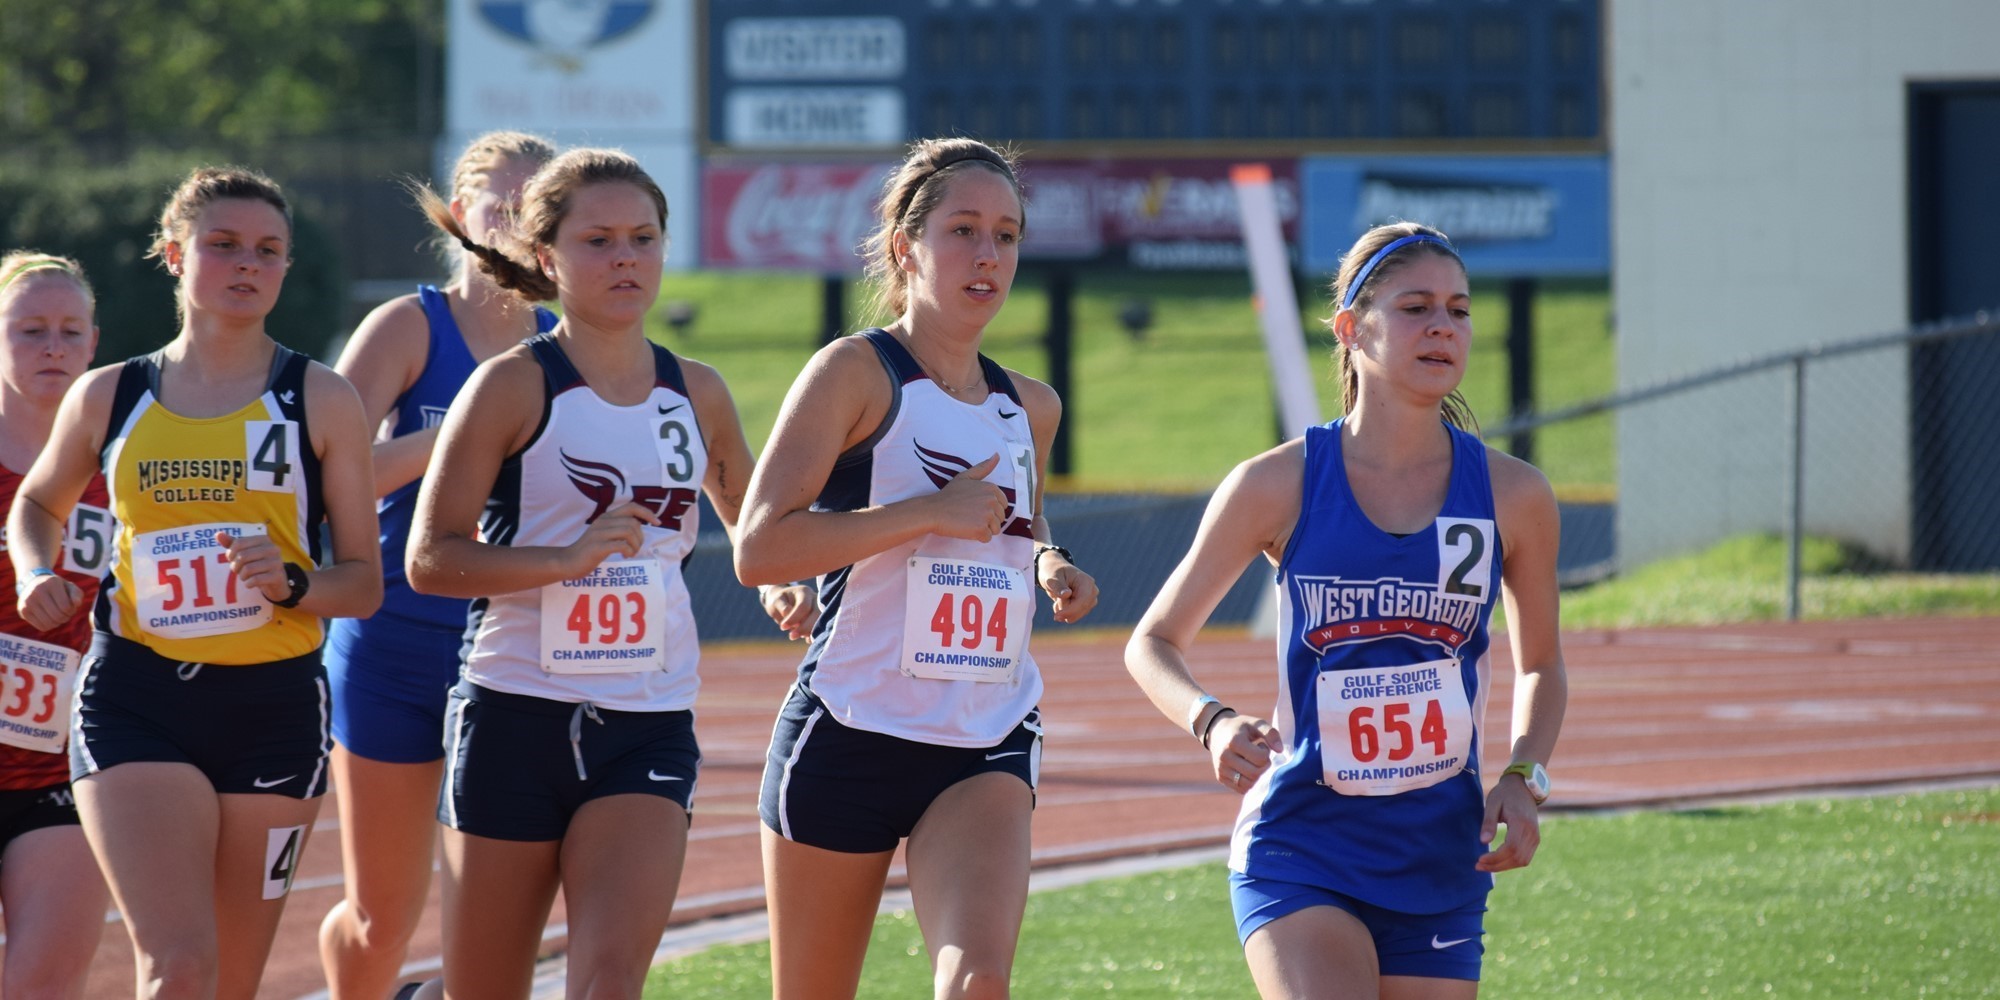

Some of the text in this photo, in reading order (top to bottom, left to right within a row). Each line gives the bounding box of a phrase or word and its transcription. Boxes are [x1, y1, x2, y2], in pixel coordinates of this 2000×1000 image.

[743, 31, 886, 62] VISITOR
[755, 103, 867, 133] HOME
[253, 423, 291, 487] 4
[659, 420, 694, 483] 3
[138, 459, 249, 492] MISSISSIPP
[1017, 448, 1033, 515] 1
[154, 488, 236, 503] COLLEGE
[72, 507, 104, 570] 5
[152, 537, 222, 556] CONFERE
[155, 531, 190, 547] GULF
[606, 565, 646, 578] SOUTH
[931, 563, 1008, 580] GULF SOUTH
[1444, 523, 1485, 598] 2
[157, 552, 238, 611] 517
[562, 575, 649, 588] CONFERENCE
[928, 573, 1013, 591] CONFERENCE
[149, 605, 262, 628] CHAMPIONSHIP
[567, 591, 646, 645] 493
[1303, 582, 1479, 633] WEST GEORGIA
[930, 592, 1008, 652] 494
[1321, 622, 1459, 644] WOLVES
[0, 638, 68, 662] ULF SOUTH
[552, 647, 656, 661] CHAMPIONSHIP
[914, 651, 1012, 669] CHAMPIONSHIP
[1340, 678, 1443, 700] CONFERENCE
[1343, 667, 1438, 688] GULF SOUTH
[0, 663, 57, 723] 33
[0, 718, 58, 740] PIONSHIP
[1348, 698, 1448, 763] 654
[1337, 756, 1459, 782] CHAMPIONSHIP
[270, 829, 300, 890] 4
